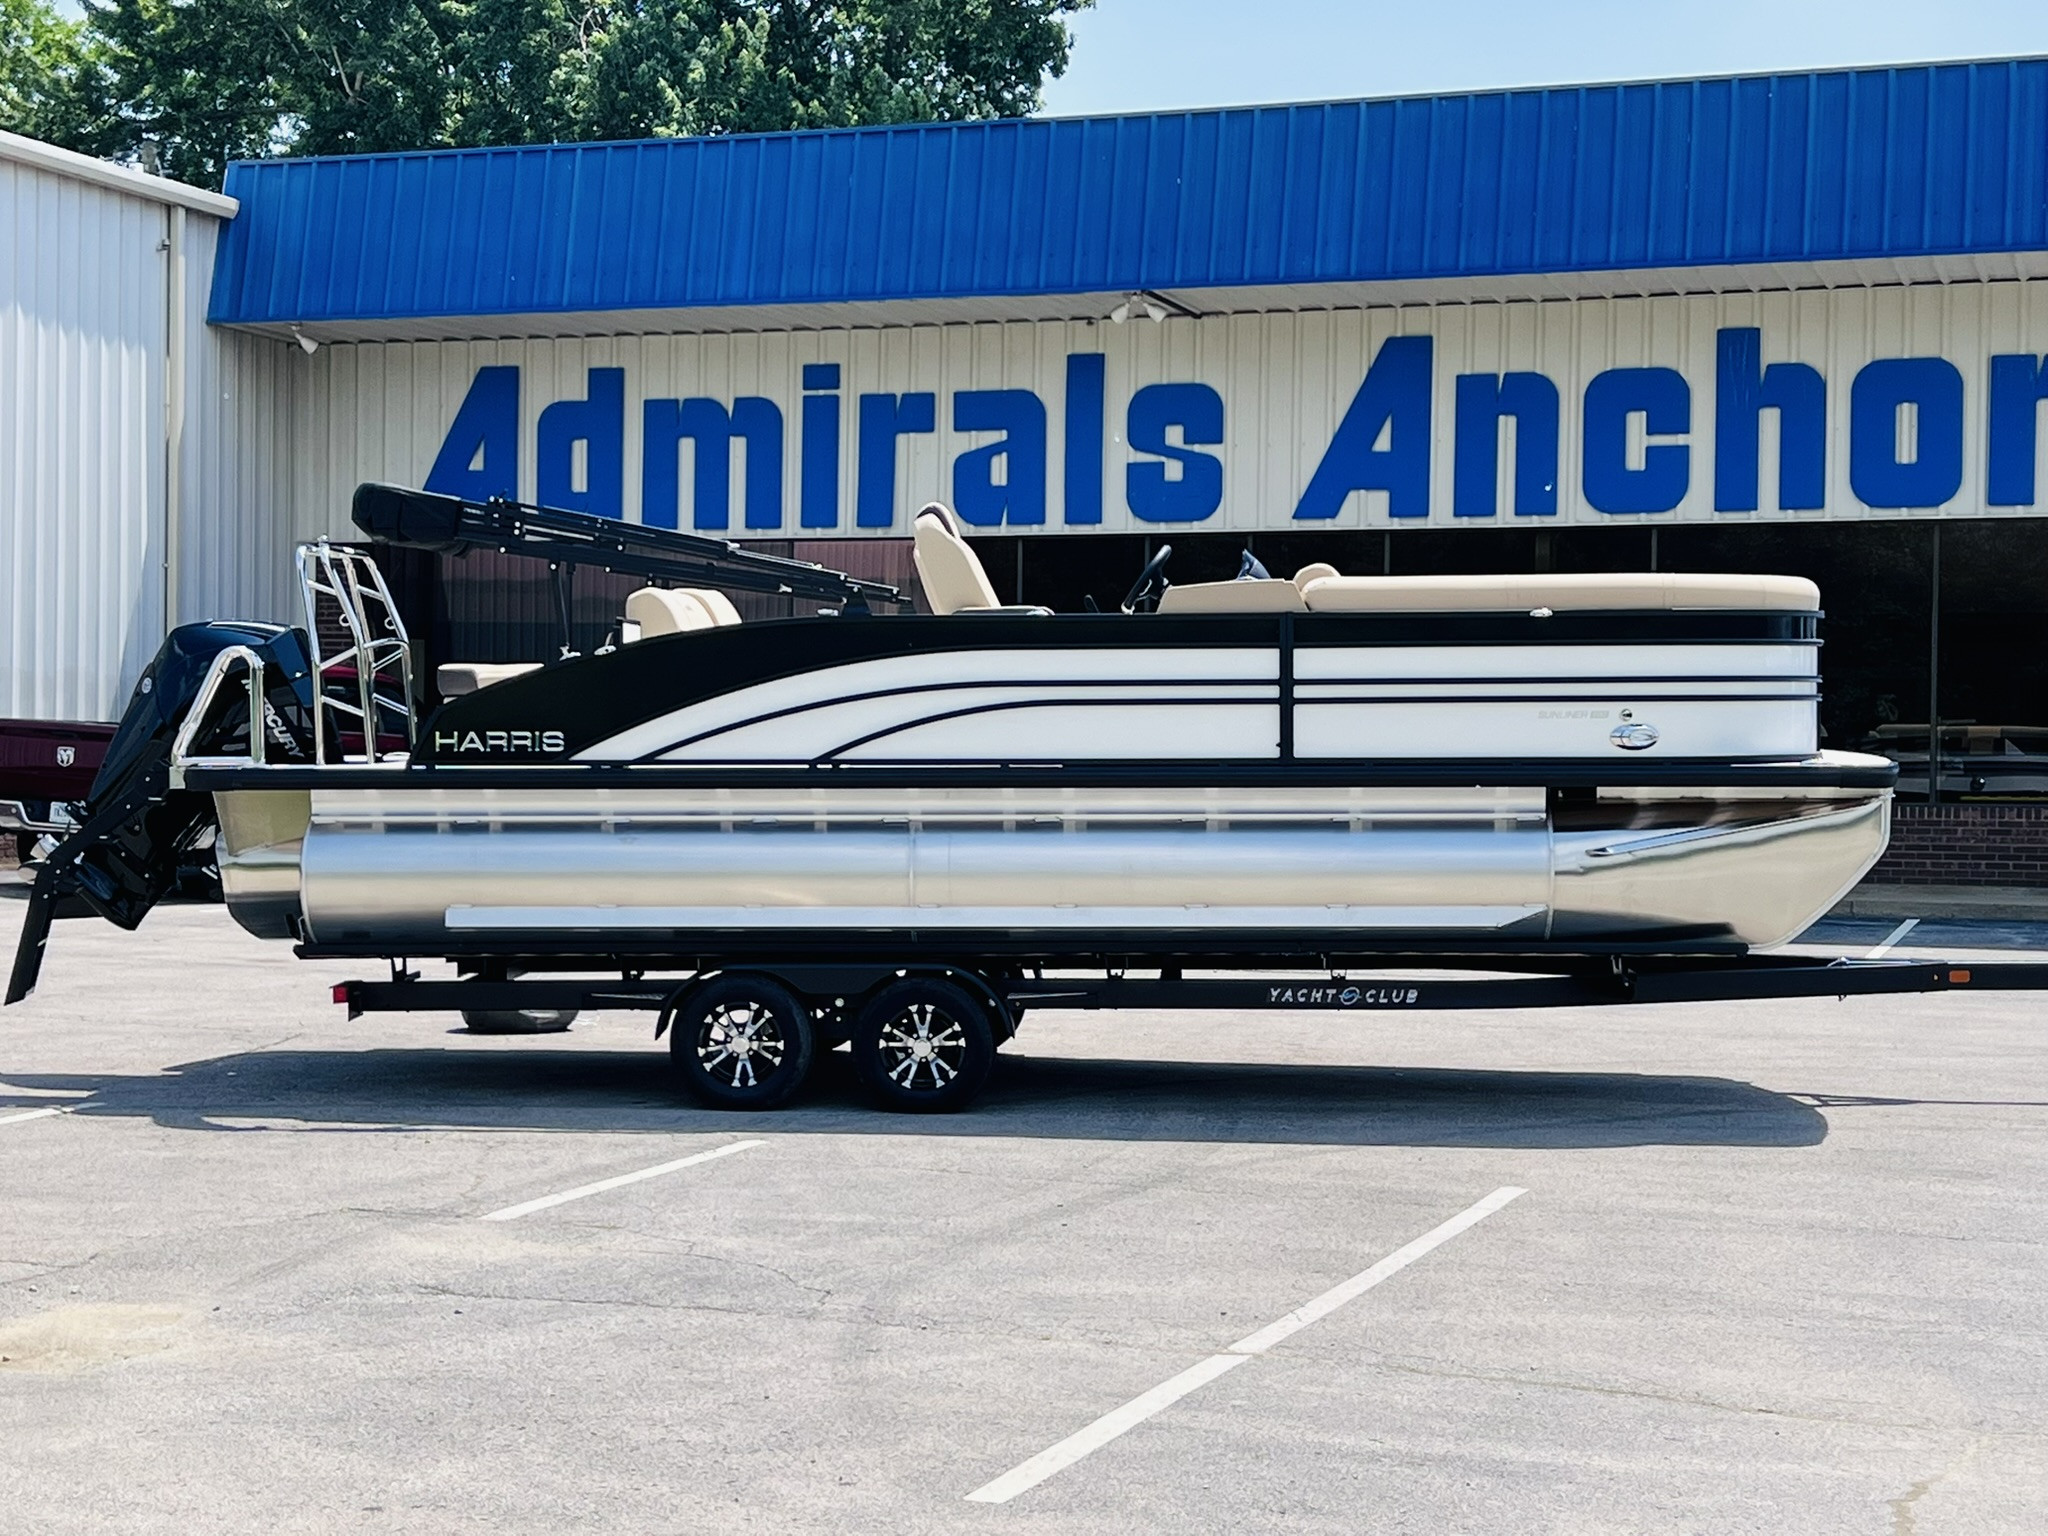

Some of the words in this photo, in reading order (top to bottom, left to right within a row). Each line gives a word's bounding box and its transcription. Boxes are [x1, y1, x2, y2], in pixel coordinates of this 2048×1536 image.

[423, 352, 1224, 530] Admirals
[241, 679, 305, 757] RCURY
[434, 731, 565, 752] HARRIS
[1269, 988, 1337, 1003] YACHT
[1365, 989, 1419, 1003] CLUB
